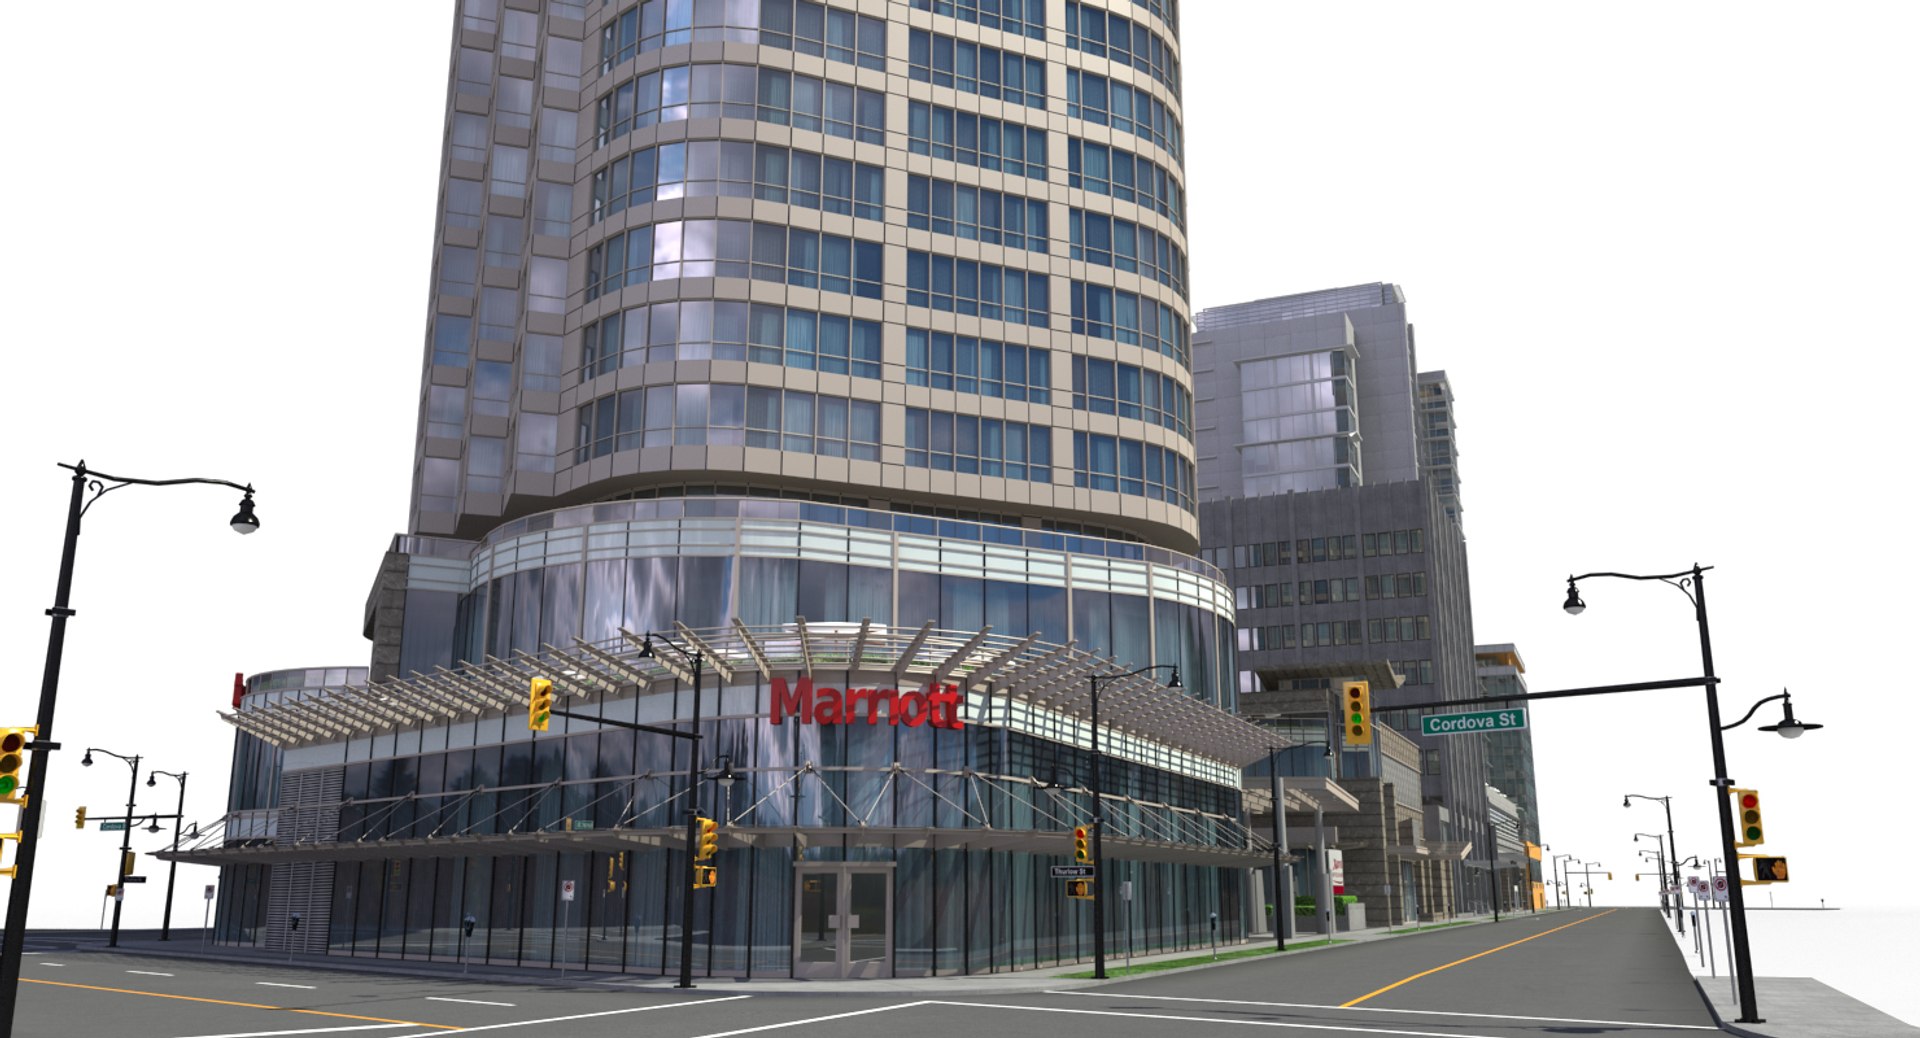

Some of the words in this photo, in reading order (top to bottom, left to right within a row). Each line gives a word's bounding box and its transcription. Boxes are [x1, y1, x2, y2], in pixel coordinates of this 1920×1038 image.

[770, 677, 964, 730] Marriott
[1430, 716, 1495, 731] Cordova
[1499, 713, 1516, 726] St
[1054, 867, 1078, 875] Thurlow
[1079, 867, 1086, 875] St
